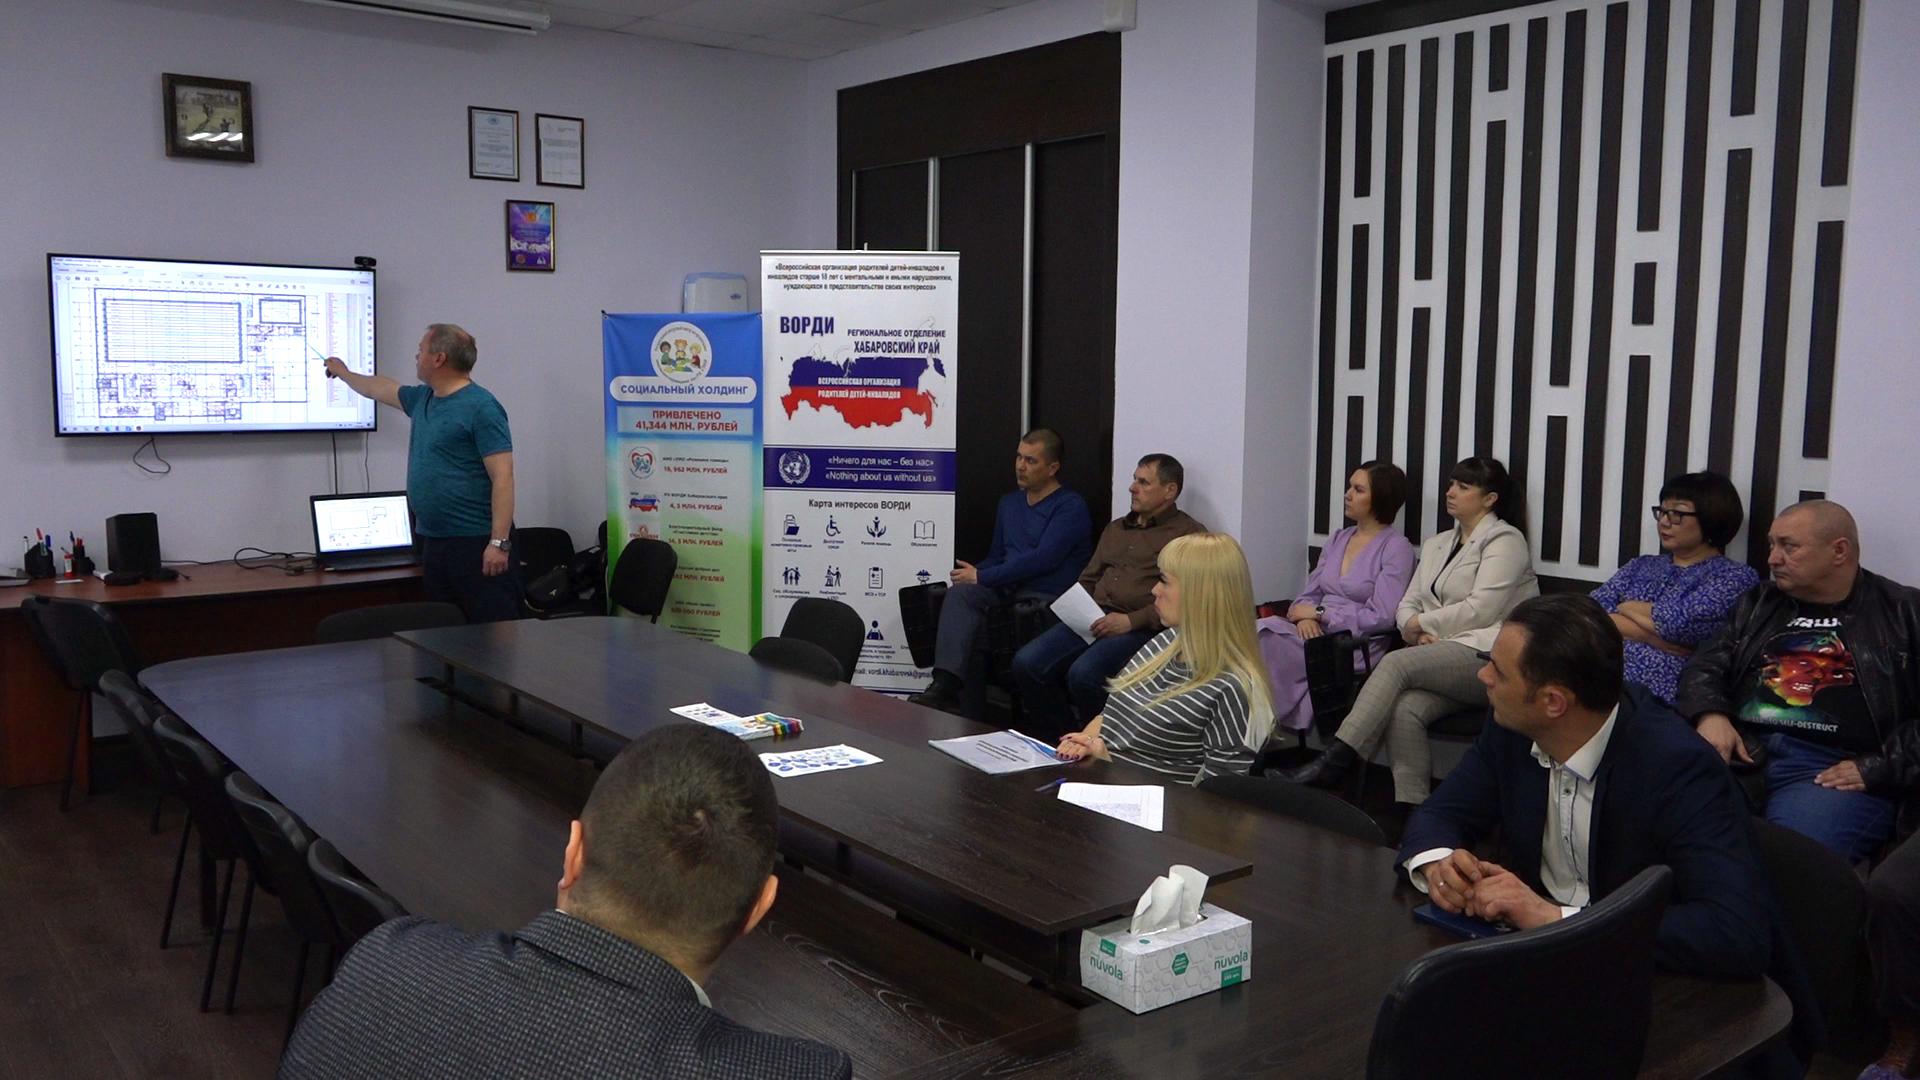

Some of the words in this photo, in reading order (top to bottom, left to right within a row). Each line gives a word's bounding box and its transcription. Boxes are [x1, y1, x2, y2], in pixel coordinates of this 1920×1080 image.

[822, 264, 858, 273] организация
[858, 263, 889, 273] родителей
[799, 273, 820, 281] старше
[829, 273, 839, 281] лет
[780, 316, 834, 336] ВОРДИ
[847, 329, 902, 338] РЕГИОНАЛЬНОЕ
[903, 330, 946, 339] ОТДЕЛЕНИЕ
[854, 338, 915, 354] ХАБАРОВСКИЙ
[917, 339, 940, 354] КРАЙ
[818, 376, 863, 385] ВСЕРОССИЙСКАЯ
[620, 383, 695, 396] СОЦИАЛЬНЫЙ
[697, 385, 749, 397] ХОЛДИНГ
[818, 389, 849, 398] РОДИТЕЛЕЙ
[652, 410, 722, 420] ПРИВЛЕЧЕНО
[635, 421, 667, 431] 41,344
[669, 422, 695, 431] МЛН.
[698, 420, 738, 431] РУБЛЕЙ
[828, 456, 860, 465] «Ничего
[861, 457, 877, 466] для
[877, 458, 892, 466] нас
[899, 456, 914, 466] без
[915, 458, 934, 467] нас»
[702, 466, 728, 474] РУБЛЕЙ
[825, 471, 858, 482] «Nothing
[860, 471, 882, 481] about
[883, 473, 892, 481] us
[894, 472, 921, 482] without
[922, 474, 937, 483] us»
[808, 498, 833, 510] Карта
[834, 501, 879, 511] интересов
[880, 500, 911, 511] ВОРДИ
[1213, 949, 1249, 970] nuvola
[1089, 955, 1124, 981] nuvola
